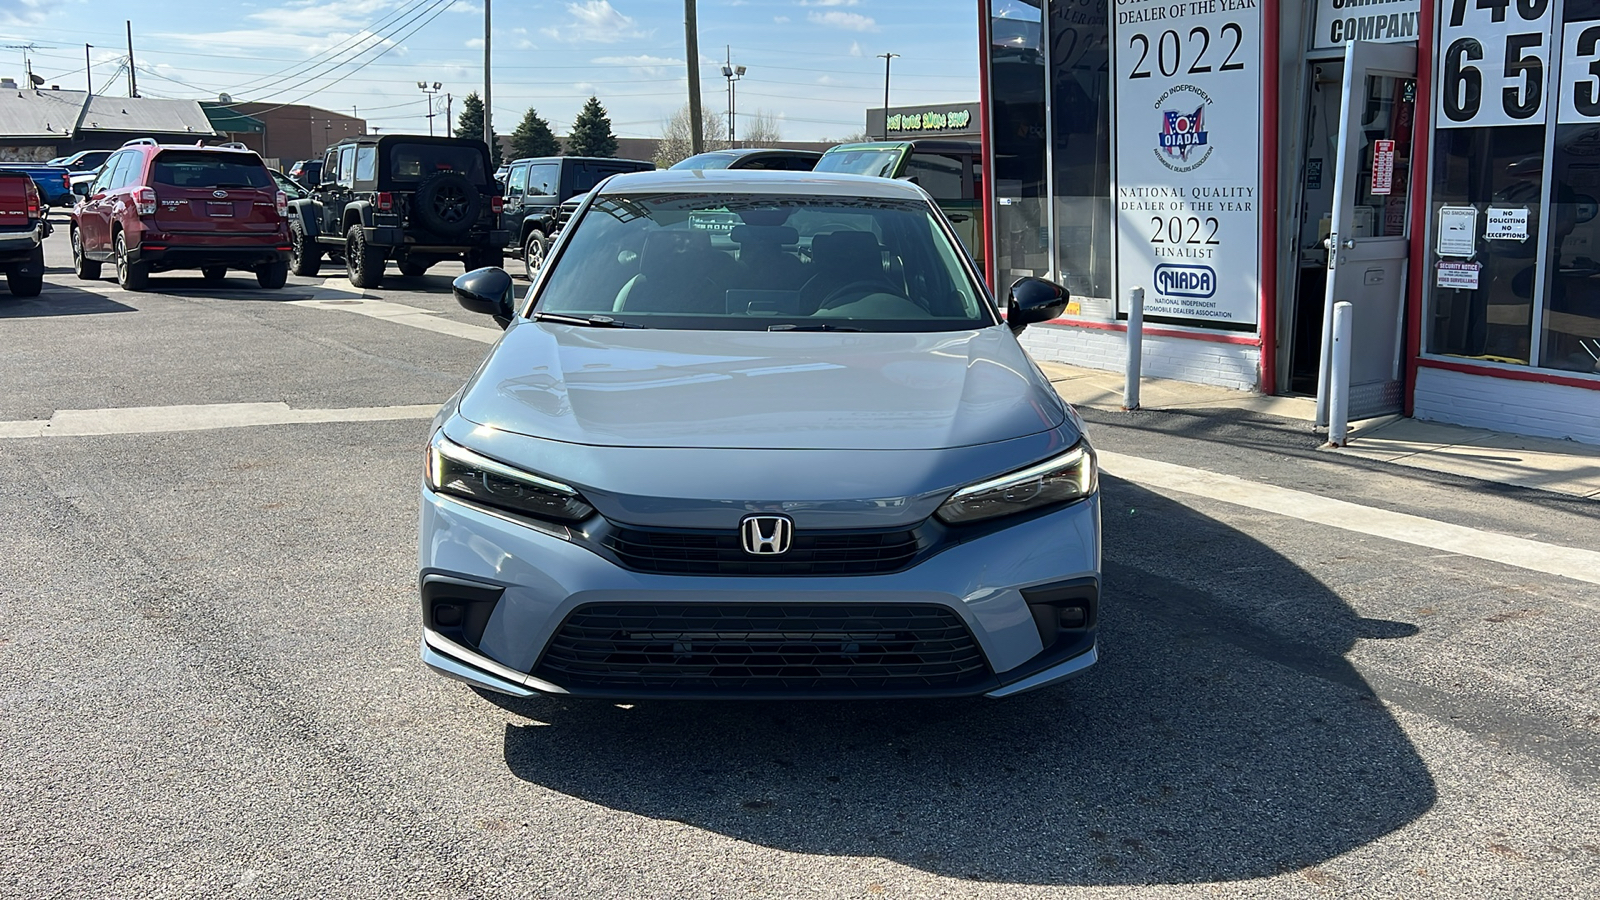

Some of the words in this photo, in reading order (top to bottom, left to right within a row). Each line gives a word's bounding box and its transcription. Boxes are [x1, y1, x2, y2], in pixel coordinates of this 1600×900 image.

[1119, 6, 1166, 25] DEALER
[1169, 4, 1186, 18] OF
[1189, 0, 1216, 15] THE
[1220, 0, 1256, 11] YEAR
[1128, 22, 1244, 79] 2022
[1154, 92, 1169, 109] OHIO
[1169, 84, 1213, 105] INDEPENDENT
[948, 110, 969, 127] SHOP
[1164, 133, 1200, 146] OIADA
[1120, 187, 1186, 198] NATIONAL
[1192, 187, 1254, 199] QUALITY
[1121, 202, 1165, 211] DEALER
[1170, 202, 1185, 211] OF
[1190, 202, 1213, 211] THE
[1219, 202, 1252, 211] YEAR
[1150, 216, 1220, 245] 2022
[1154, 247, 1213, 259] FINALIST
[1159, 271, 1210, 292] NIADA
[1155, 298, 1179, 306] NATIONAL
[1181, 300, 1217, 309] INDEPENDENT
[1143, 305, 1171, 314] UTOMOBILE
[1196, 310, 1232, 318] ASSOCIATION
